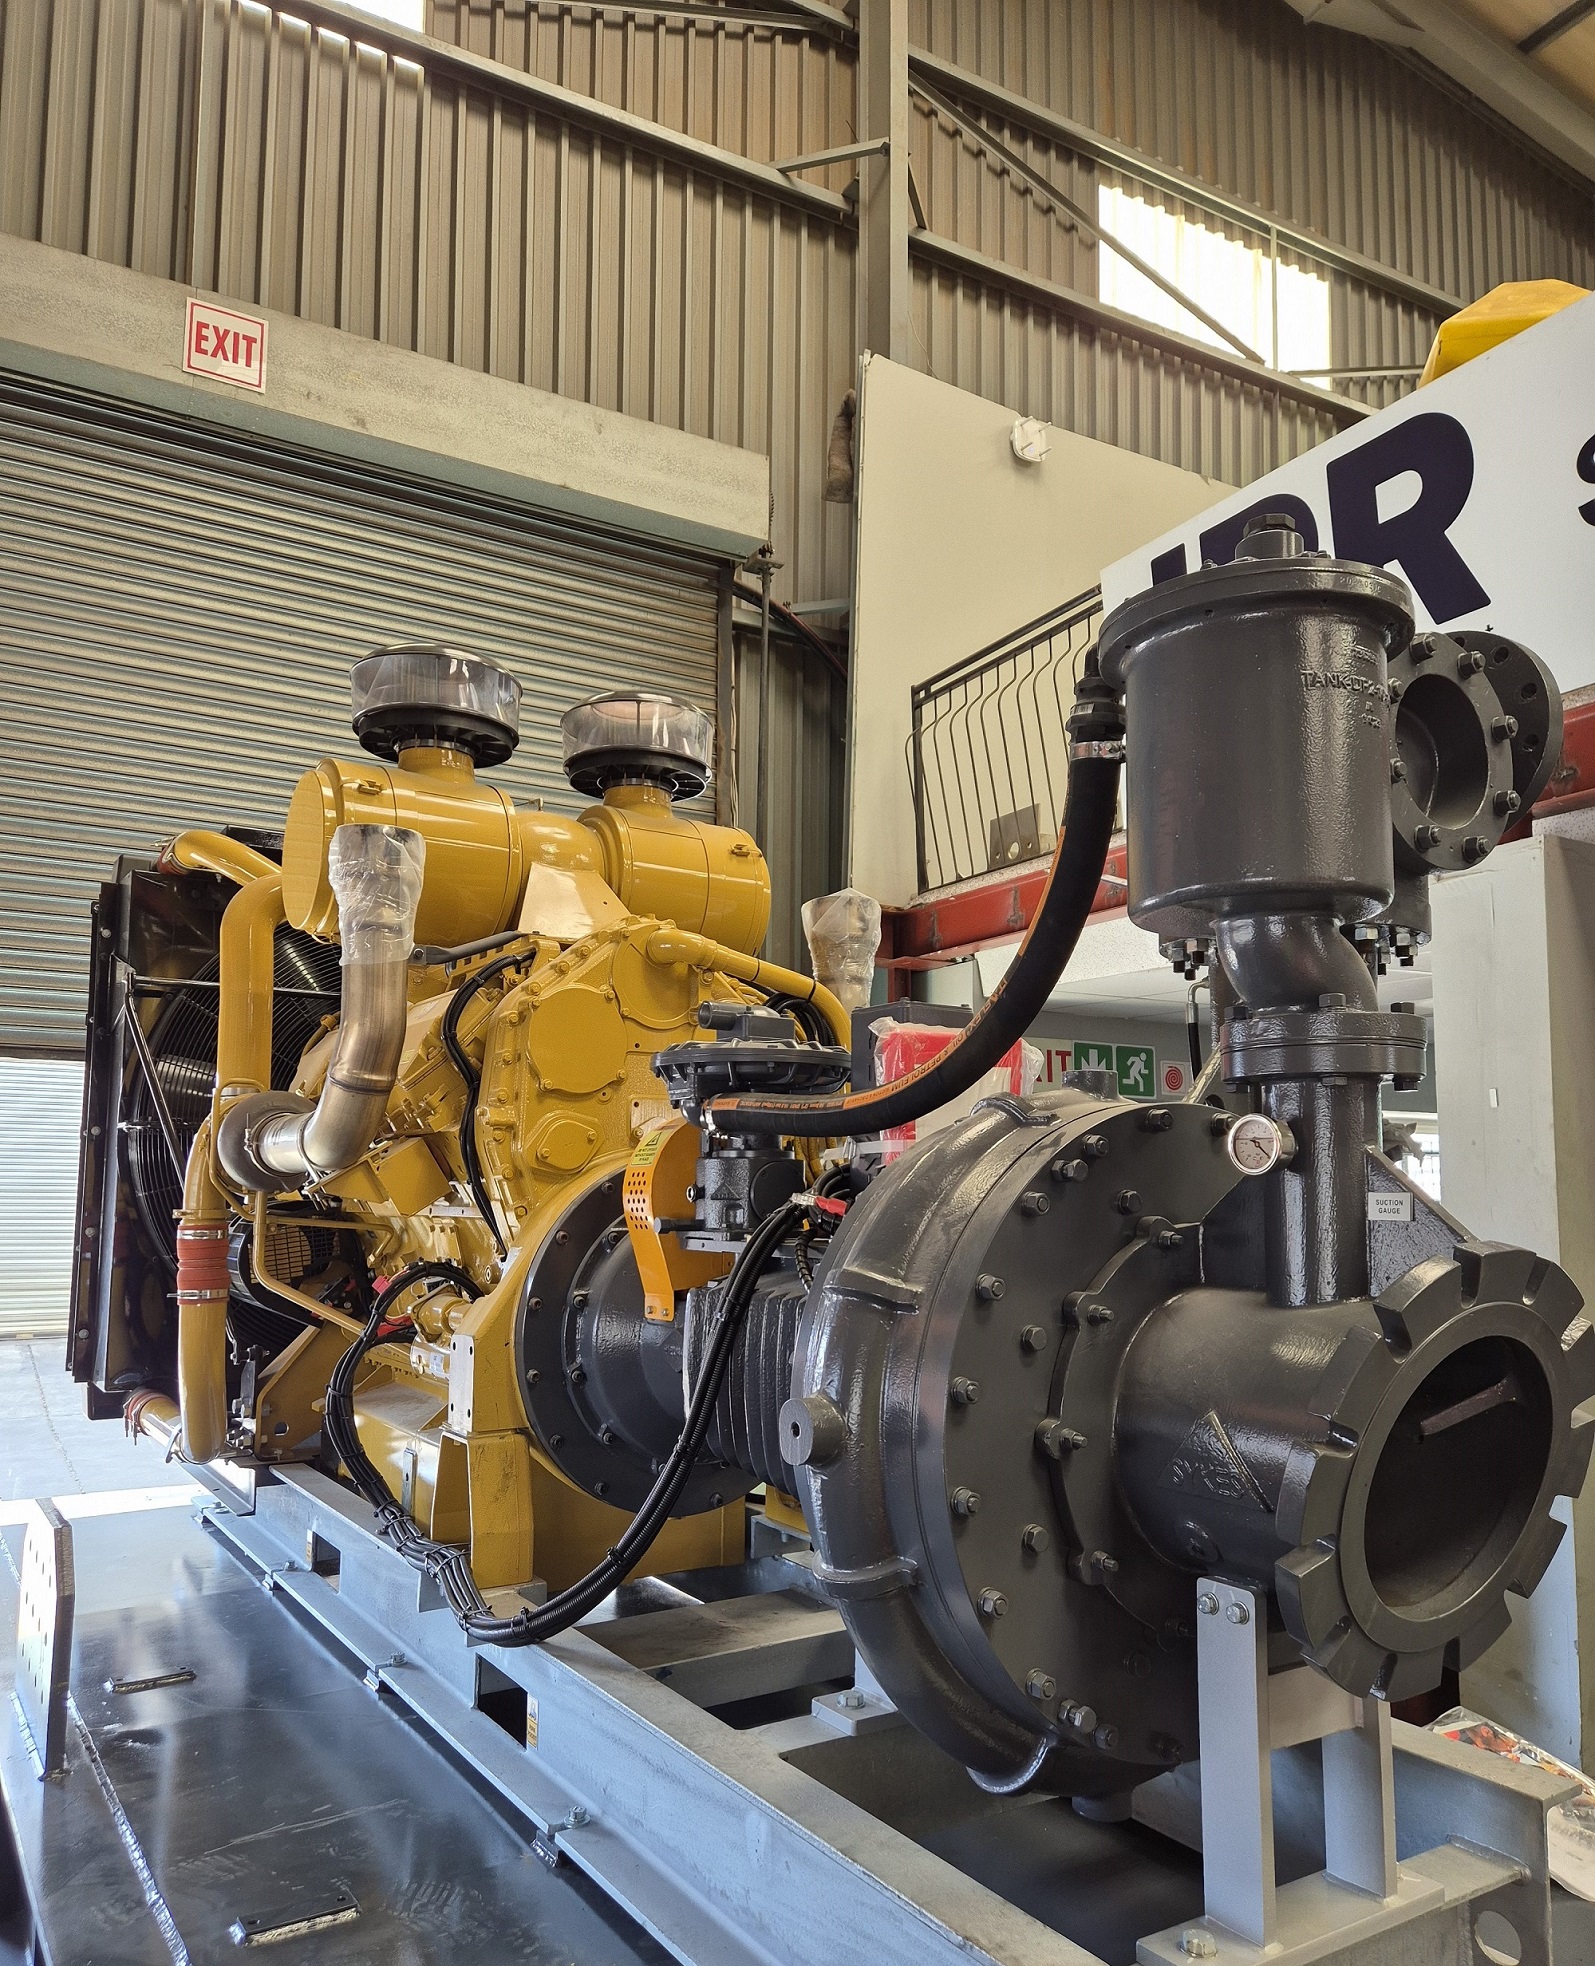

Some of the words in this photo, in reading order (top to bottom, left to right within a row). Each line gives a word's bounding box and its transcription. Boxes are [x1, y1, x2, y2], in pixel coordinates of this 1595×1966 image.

[195, 320, 258, 368] EXIT
[953, 1033, 964, 1047] OIL
[891, 1055, 942, 1093] PETROLEUM
[1036, 1049, 1072, 1083] IT
[1378, 1207, 1401, 1215] GAUGE
